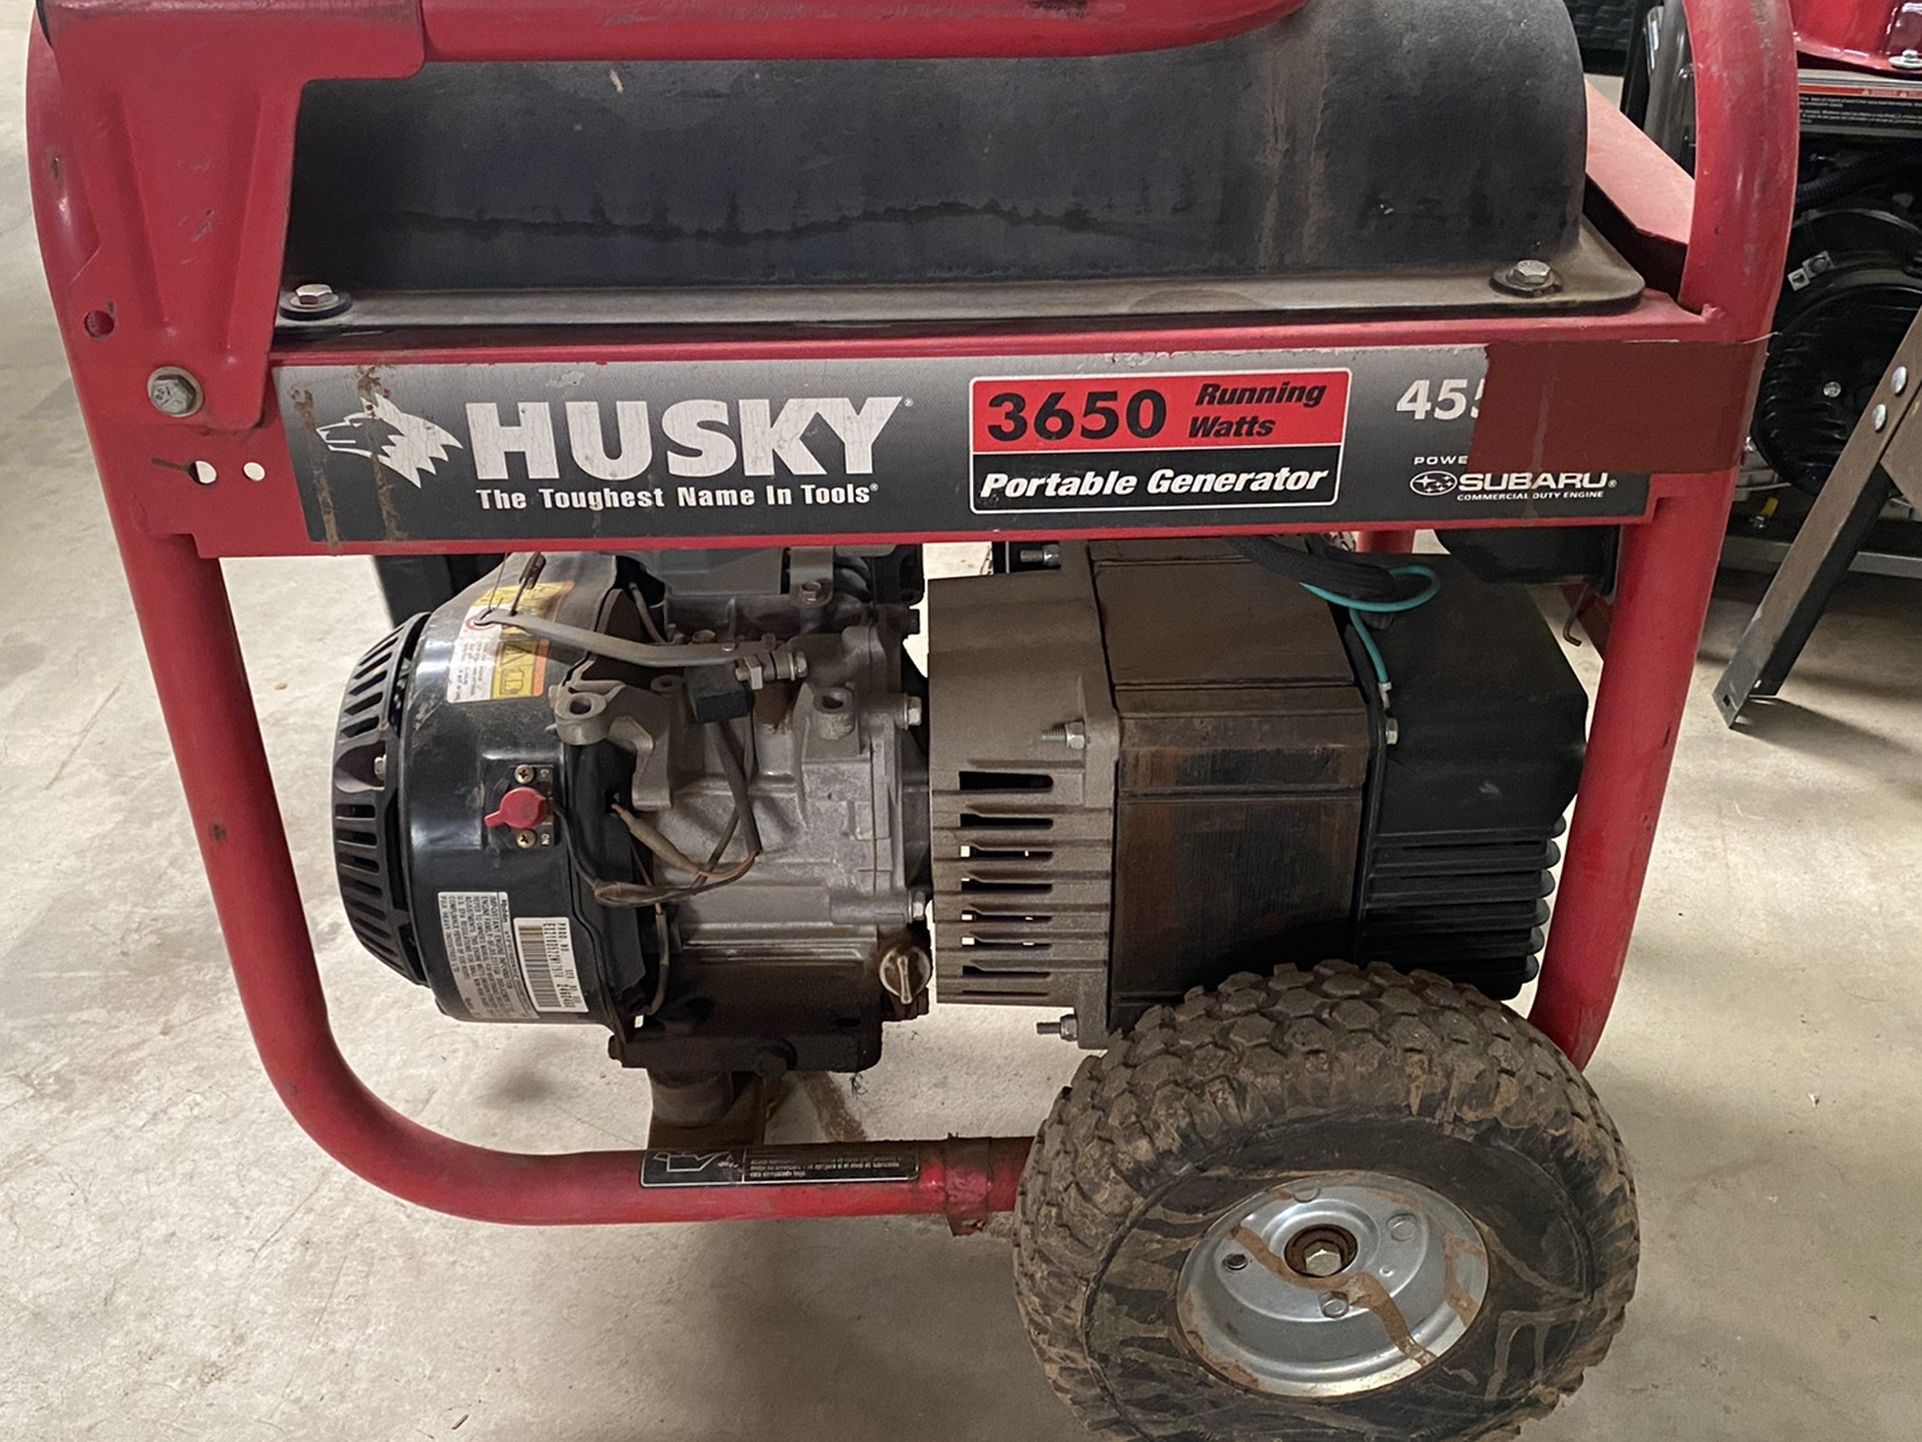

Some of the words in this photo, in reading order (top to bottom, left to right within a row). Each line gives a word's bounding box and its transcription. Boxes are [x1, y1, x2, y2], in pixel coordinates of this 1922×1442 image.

[1195, 381, 1326, 408] Running
[987, 389, 1168, 441] 3650
[1188, 415, 1276, 439] Watts
[465, 396, 903, 481] HUSKY
[979, 469, 1138, 498] Portable
[1147, 466, 1331, 495] Generator
[1457, 491, 1530, 501] COMMERCIAL
[1532, 491, 1561, 500] DUTY
[1563, 490, 1604, 499] ENGINE
[475, 488, 527, 509] The
[538, 486, 665, 511] Toughest
[677, 486, 755, 507] Name
[766, 485, 792, 505] In
